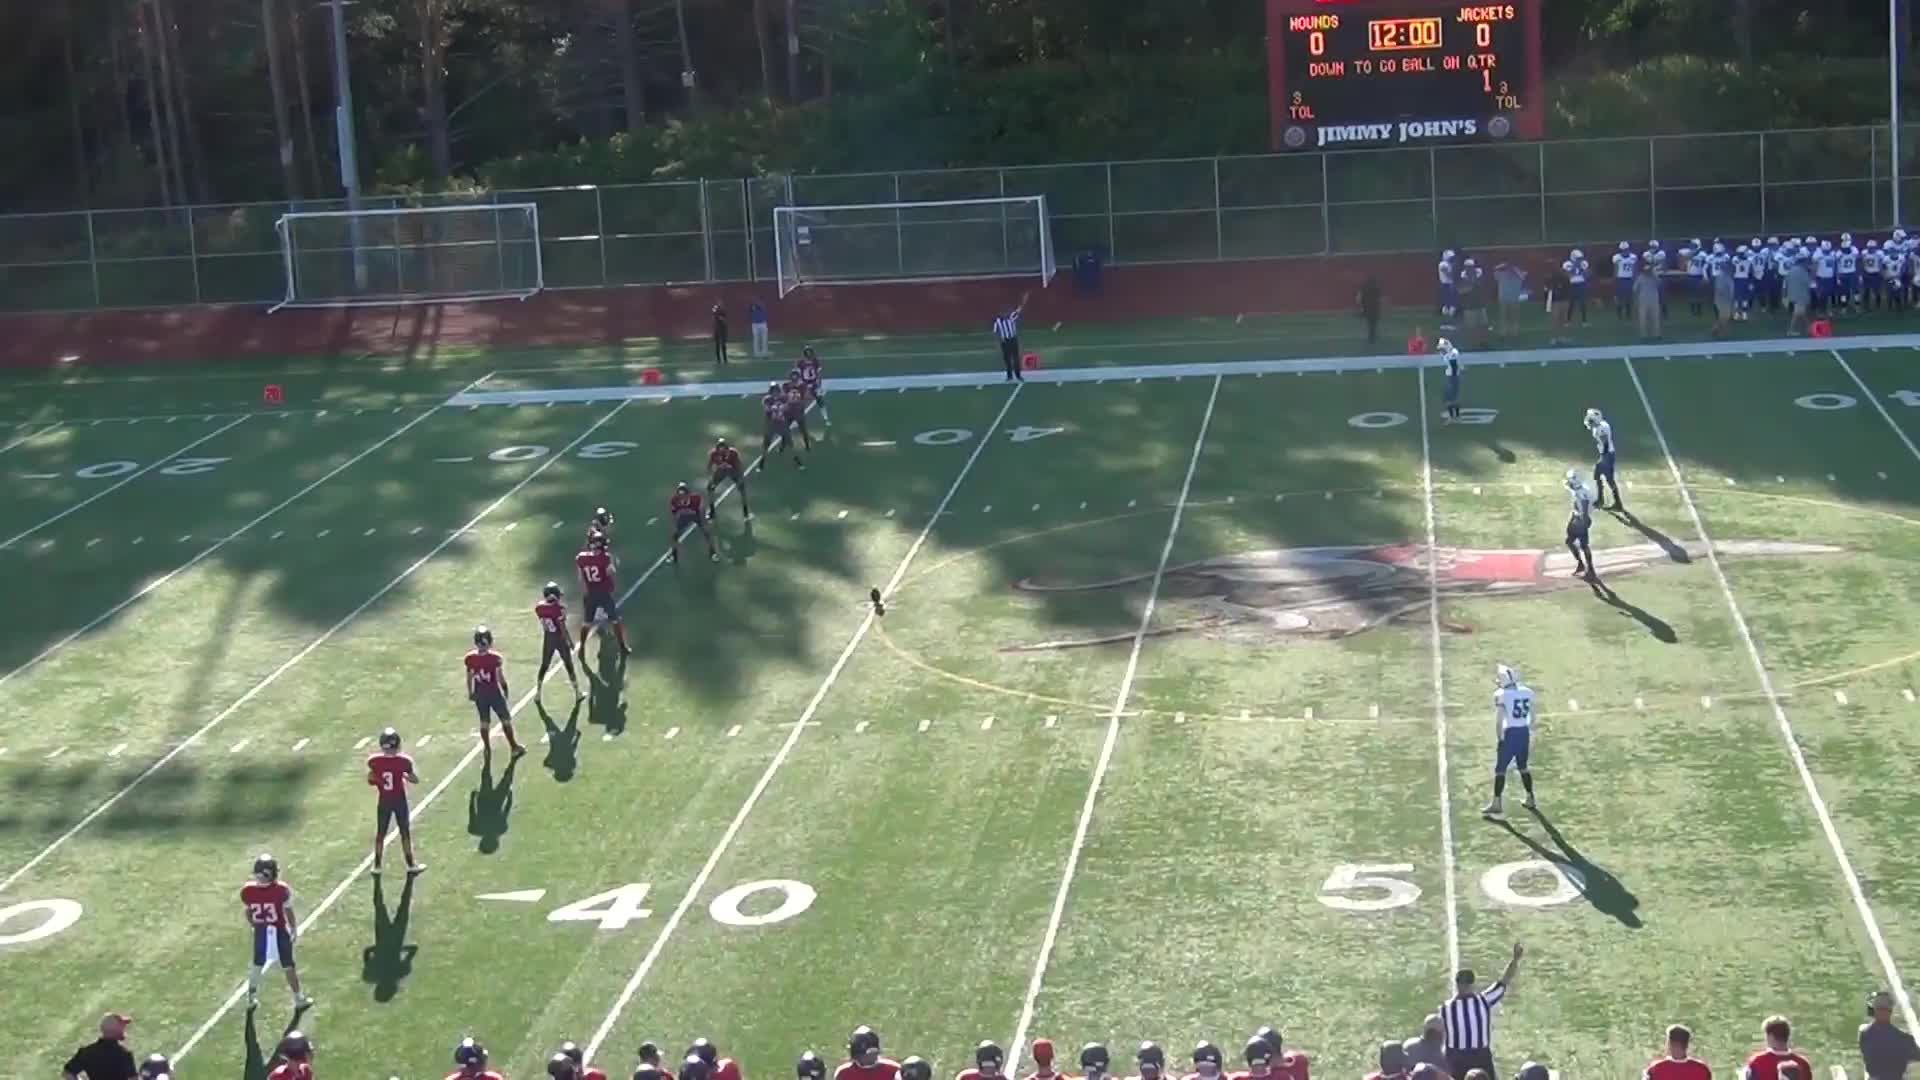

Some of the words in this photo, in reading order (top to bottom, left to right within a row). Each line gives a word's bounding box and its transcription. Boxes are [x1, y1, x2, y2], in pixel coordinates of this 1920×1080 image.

[1289, 15, 1339, 31] HOUNDS
[1456, 5, 1514, 22] JACKETS
[1310, 32, 1324, 55] 0
[1373, 21, 1436, 47] 12:00
[1477, 23, 1490, 47] 0
[1309, 61, 1345, 77] DOWN
[1354, 60, 1372, 75] TO
[1380, 59, 1396, 73] GO
[1443, 55, 1460, 70] ON
[1467, 54, 1497, 69] QTR
[1483, 69, 1492, 92] 1
[1289, 105, 1315, 119] TOL
[1496, 95, 1521, 109] TOL
[1317, 124, 1393, 147] JIMMY
[1399, 120, 1477, 143] JOHN'S
[584, 566, 602, 583] 12
[1512, 698, 1530, 719] 55
[382, 771, 394, 791] 3
[250, 903, 279, 923] 23
